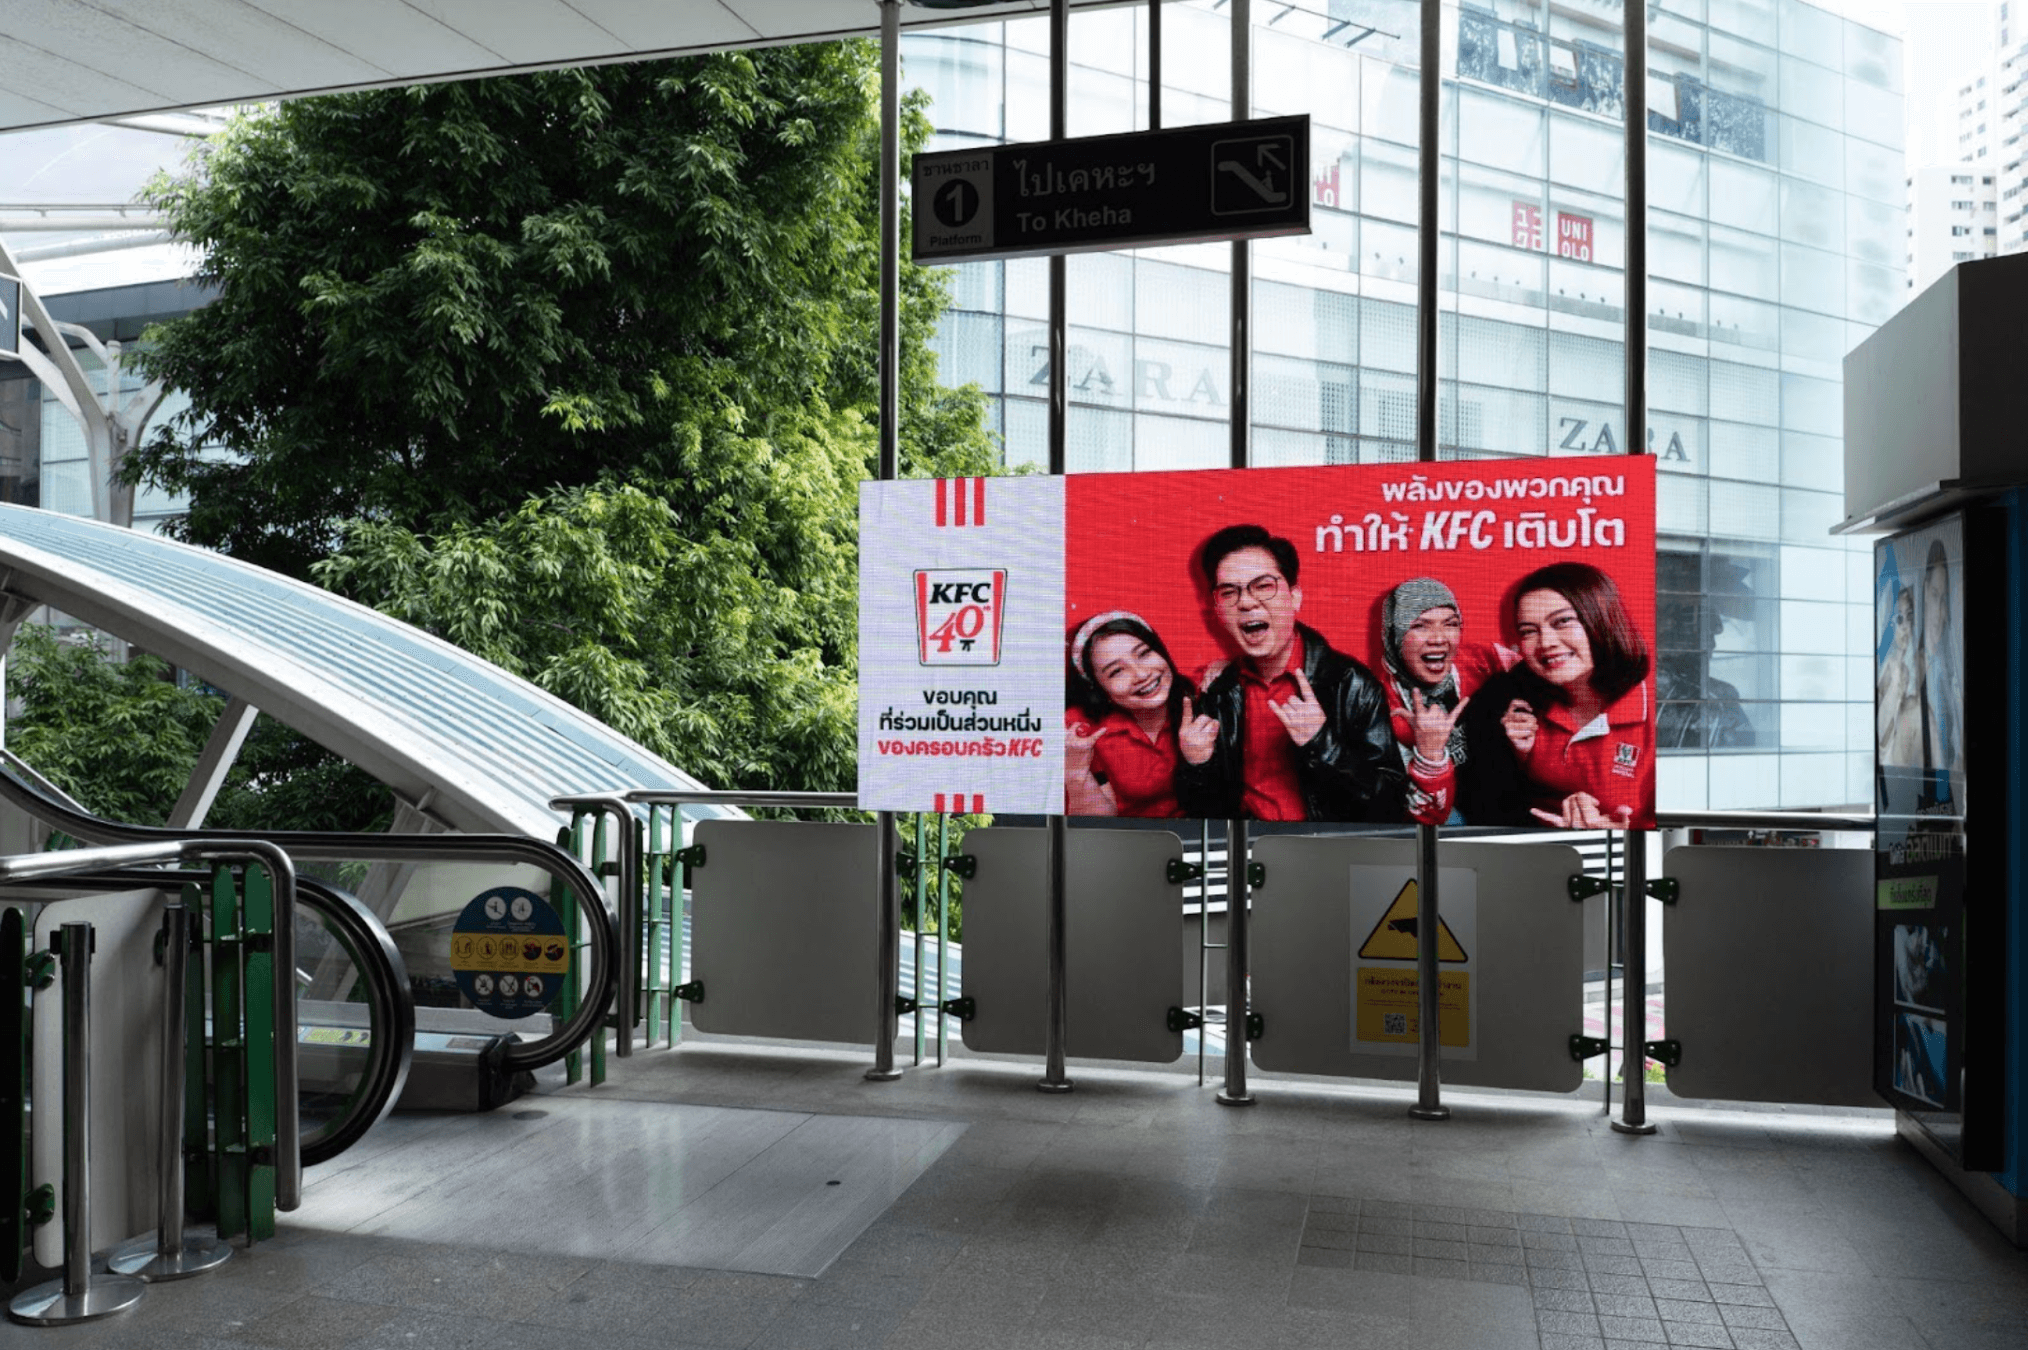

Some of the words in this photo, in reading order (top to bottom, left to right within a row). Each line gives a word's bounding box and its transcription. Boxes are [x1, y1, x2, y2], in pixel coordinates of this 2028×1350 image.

[923, 160, 989, 177] ชานชาลา
[1012, 159, 1156, 198] ไปเคหะฯ
[945, 183, 963, 222] 1
[1016, 212, 1046, 232] To
[1054, 206, 1132, 229] Kheha
[1561, 218, 1587, 241] UNI
[930, 234, 982, 247] Platform
[1381, 474, 1625, 505] พลังของพวกคุณ
[1315, 511, 1414, 552] ทำให้
[1420, 511, 1497, 550] KFC
[1504, 507, 1626, 549] เติบโต
[929, 583, 991, 604] KFC
[923, 690, 997, 709] ขอบคุณ
[879, 706, 1042, 732] ที่ร่วมเป็นส่วนหนึ่ง
